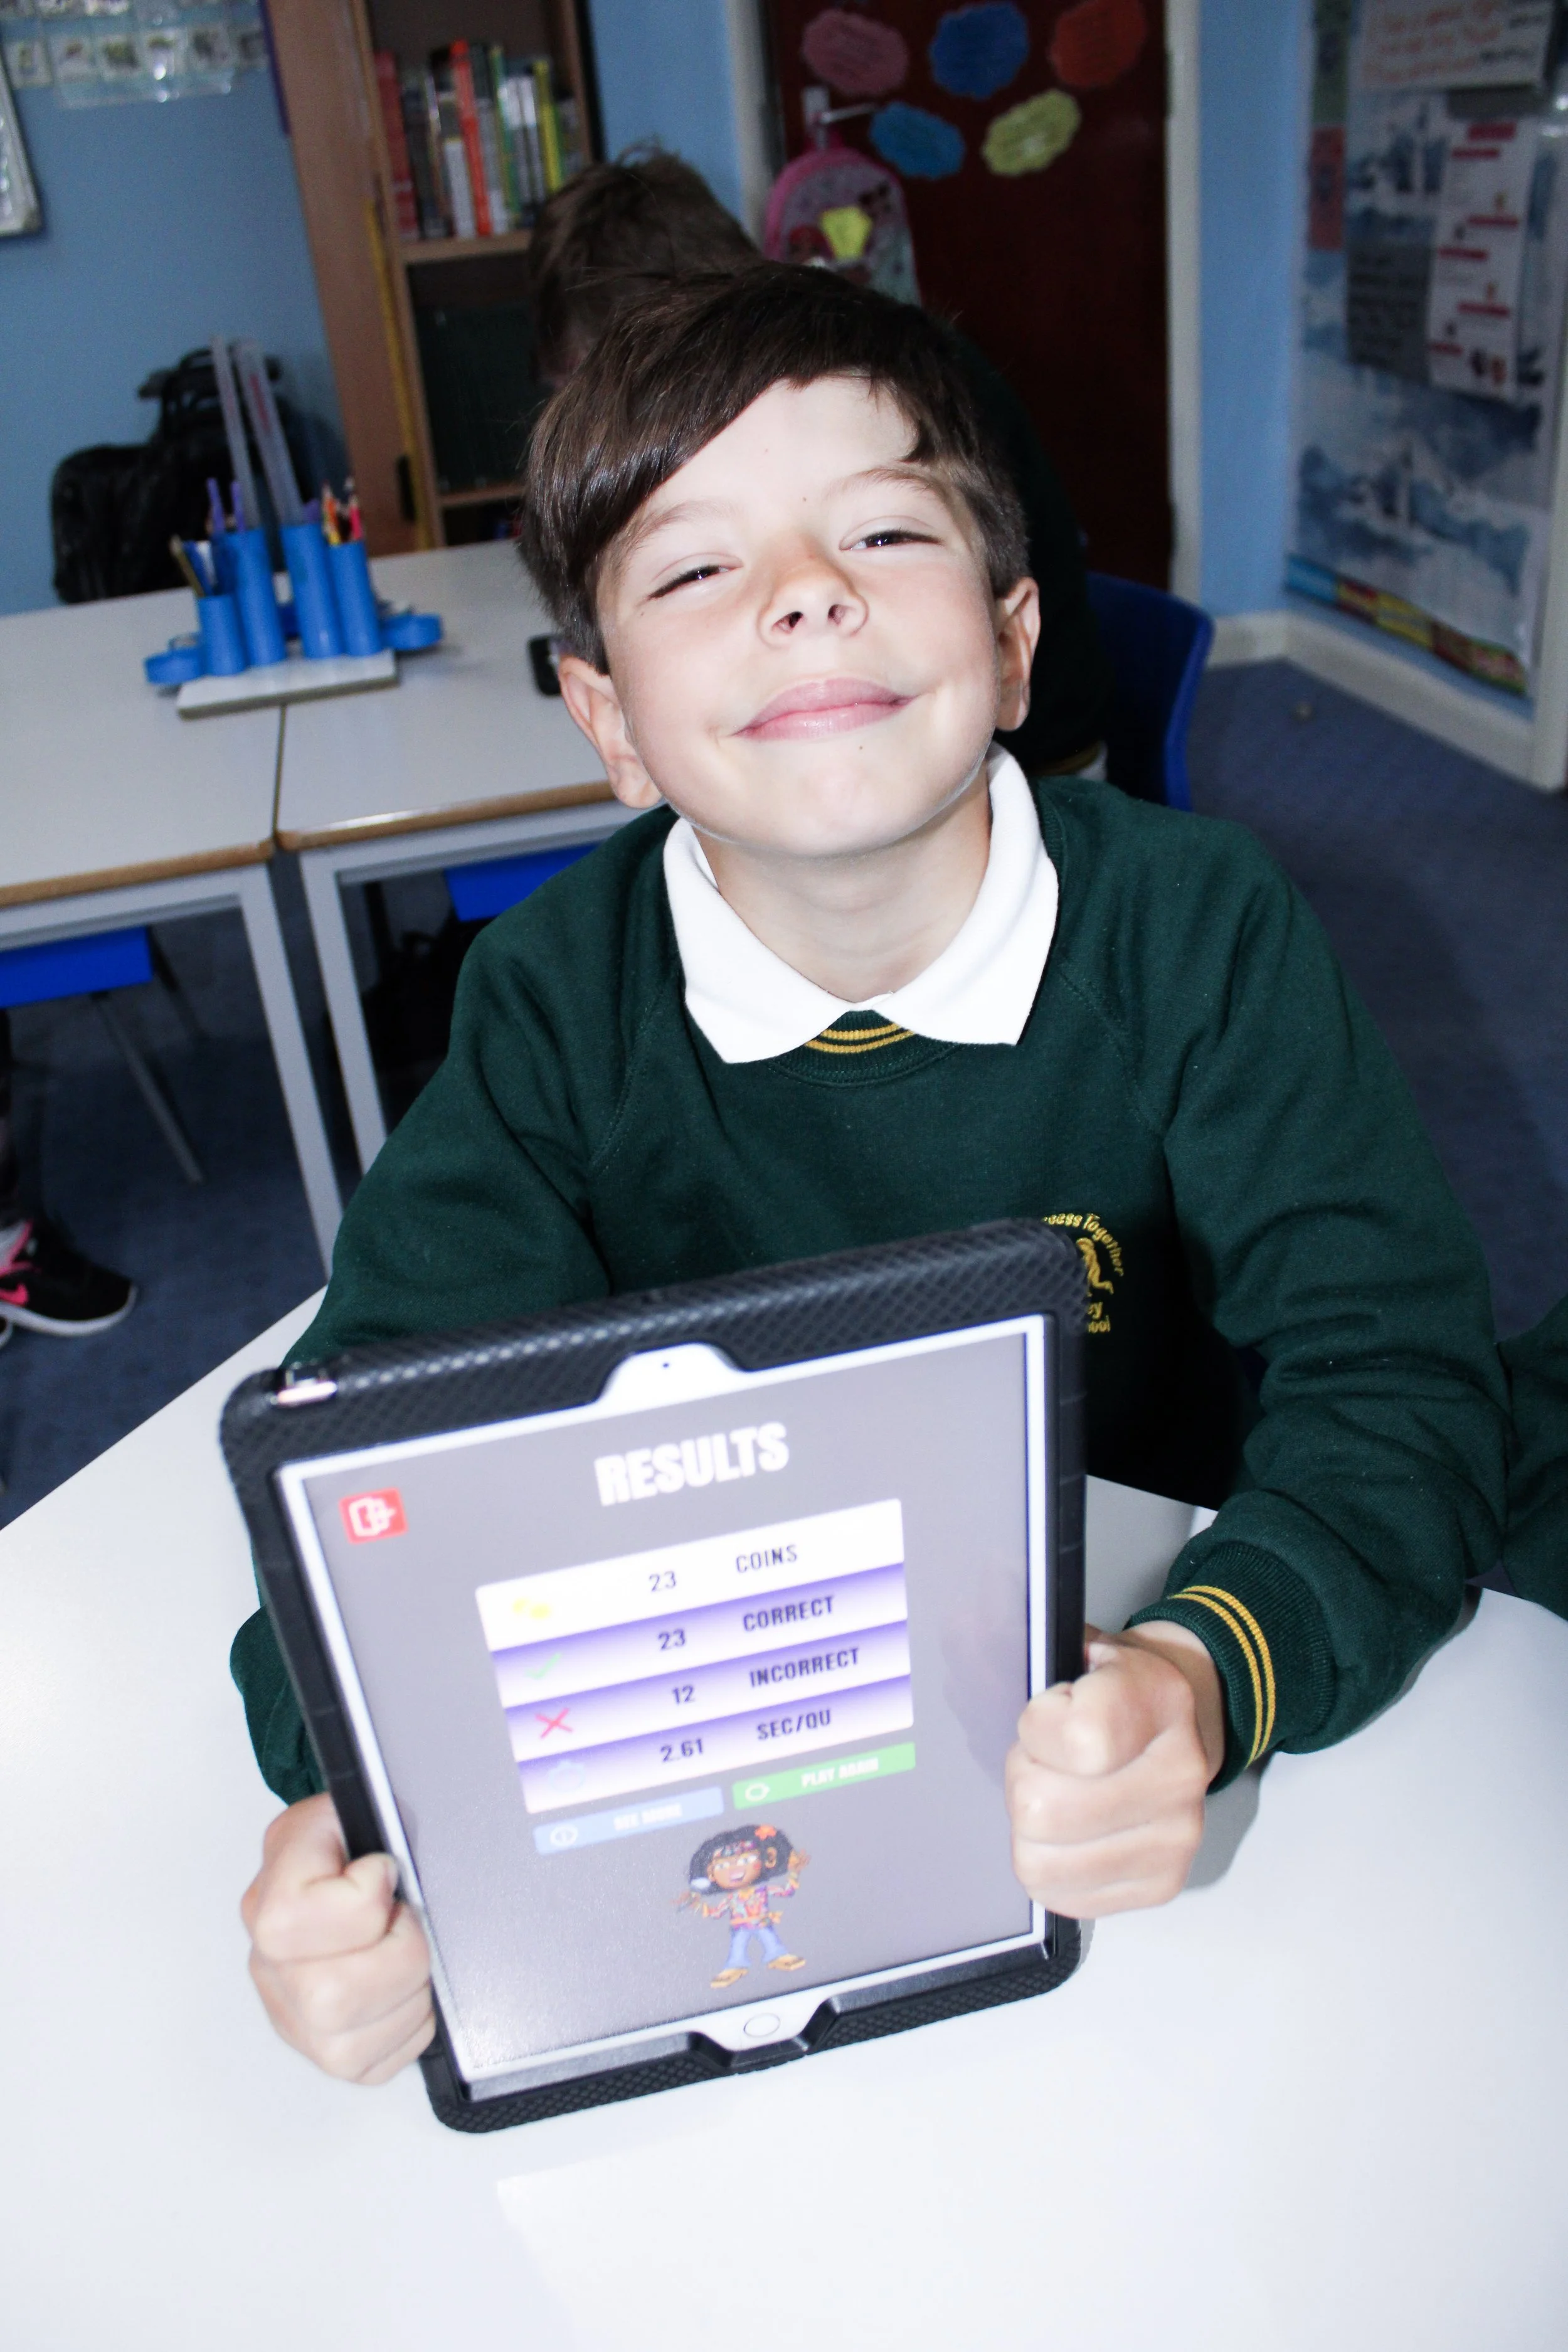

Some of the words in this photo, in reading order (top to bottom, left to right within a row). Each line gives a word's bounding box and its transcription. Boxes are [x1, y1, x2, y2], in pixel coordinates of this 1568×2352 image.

[593, 1421, 790, 1507] RESULTS
[649, 1571, 678, 1592] 23
[735, 1544, 798, 1574] COINS
[657, 1628, 687, 1651] 23
[742, 1594, 835, 1633] CORRECT
[671, 1685, 696, 1705] 12
[750, 1647, 861, 1688] INCORRECT
[660, 1737, 704, 1763] 2.61
[801, 1767, 835, 1788] PLAY
